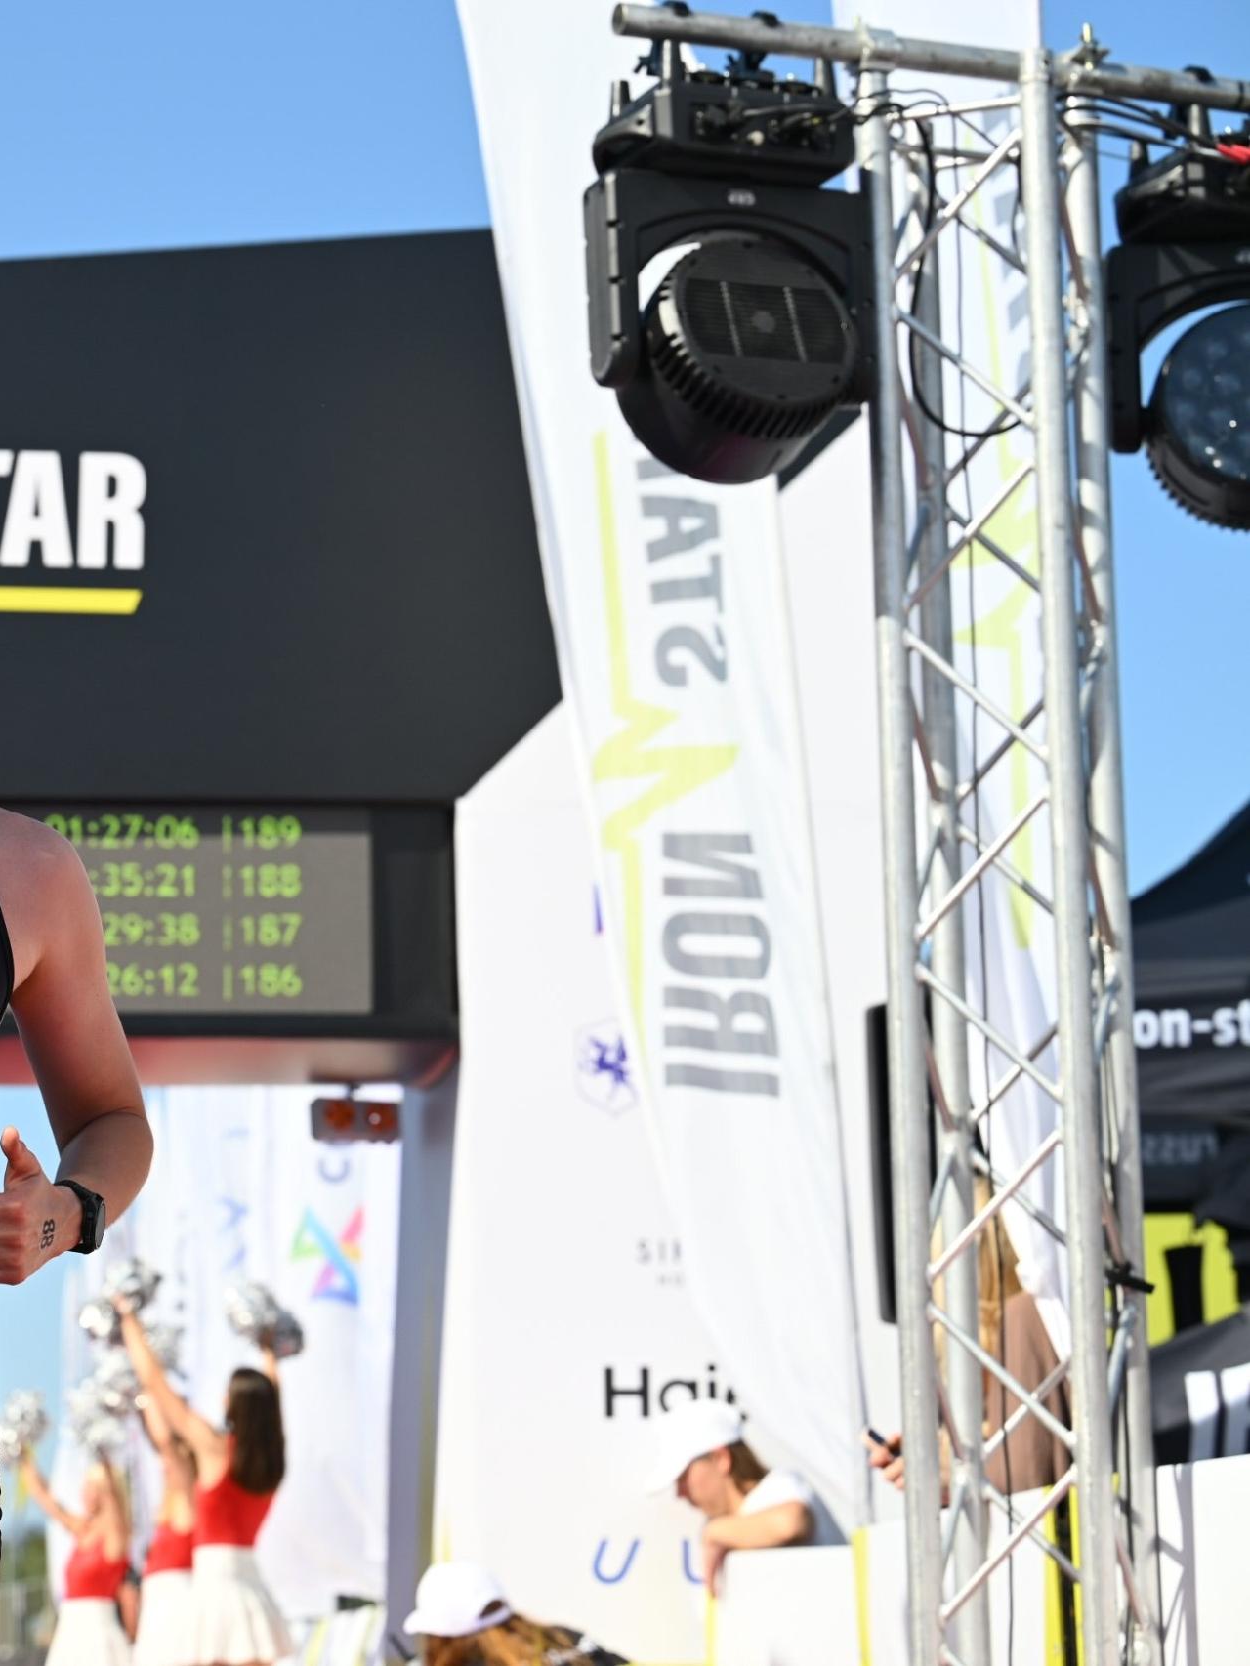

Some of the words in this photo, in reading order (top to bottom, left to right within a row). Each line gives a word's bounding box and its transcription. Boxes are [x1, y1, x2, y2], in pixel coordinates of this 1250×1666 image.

[88, 861, 196, 897] :35:21
[102, 912, 200, 946] 29:38
[105, 962, 199, 997] 26:12
[1133, 1000, 1250, 1049] on-st
[40, 1219, 56, 1249] 88
